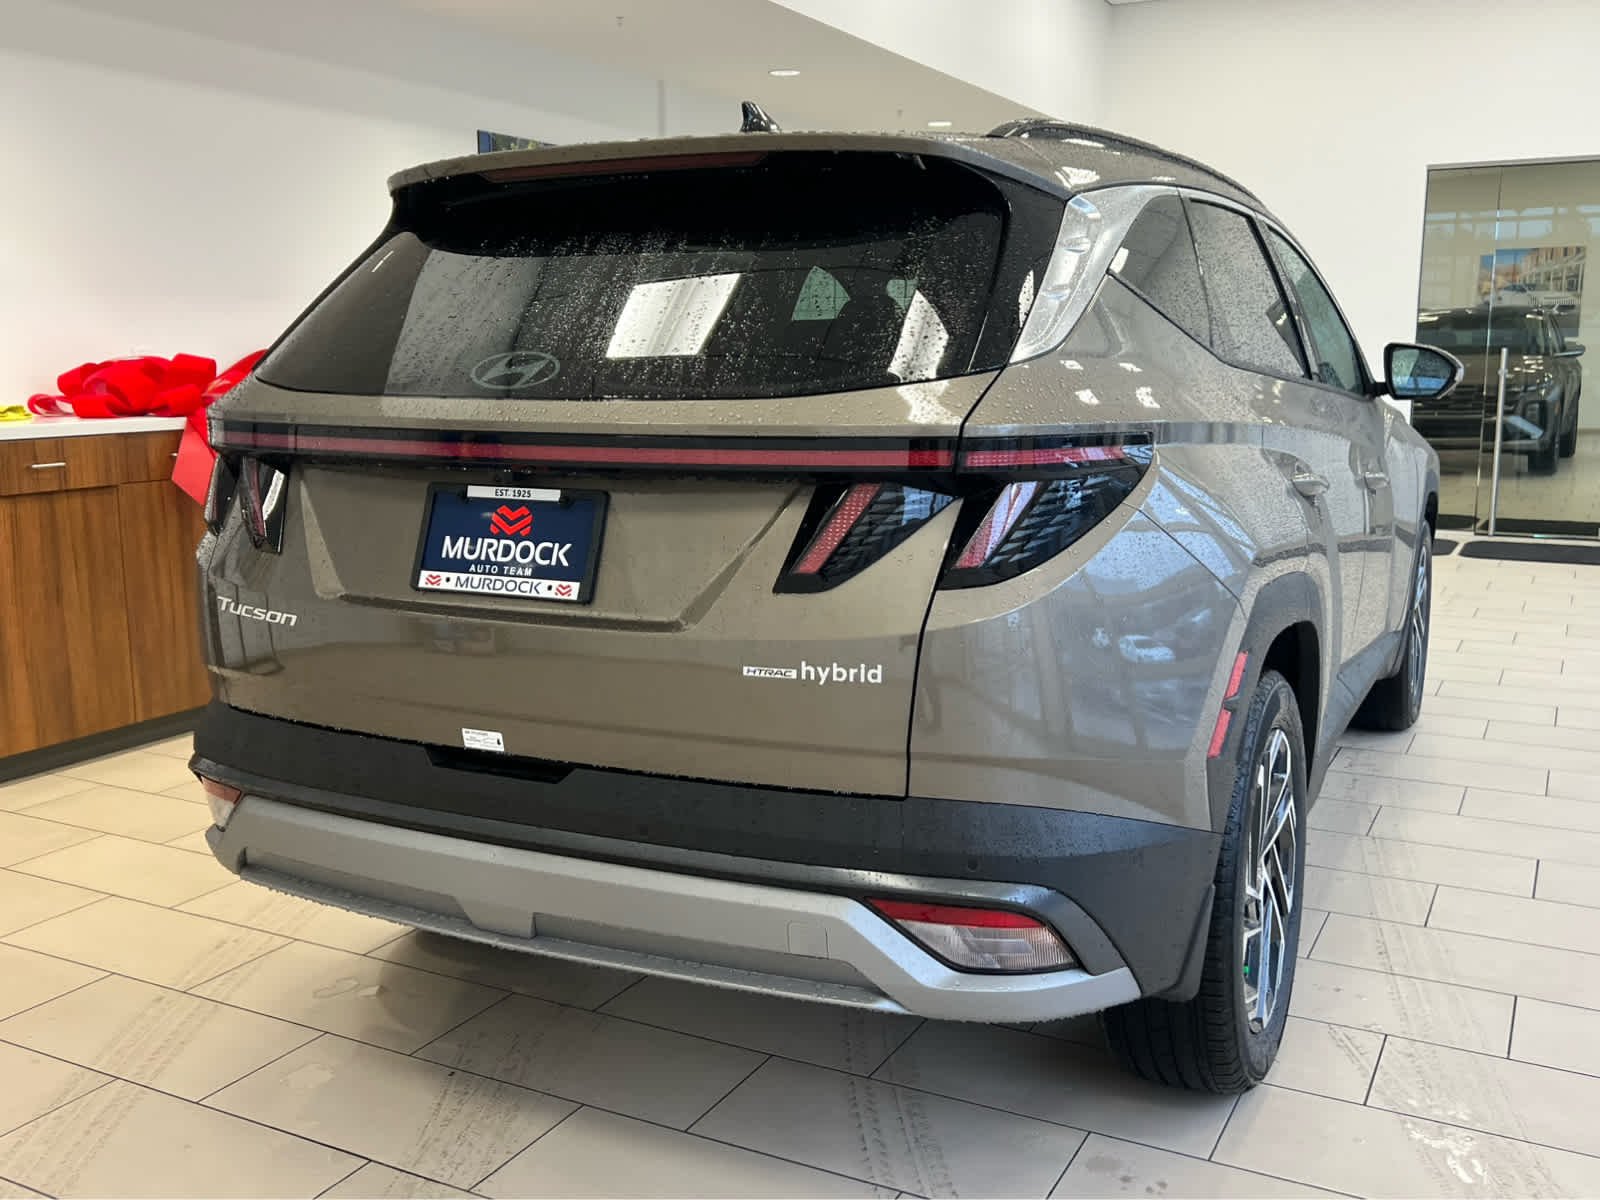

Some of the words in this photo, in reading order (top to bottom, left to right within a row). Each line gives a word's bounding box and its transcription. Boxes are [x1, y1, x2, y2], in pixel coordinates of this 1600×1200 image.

[494, 488, 511, 498] EST.
[512, 489, 532, 498] 1925
[441, 535, 572, 567] MURDOCK
[469, 563, 498, 574] AUTO
[503, 565, 533, 576] TEAM
[454, 575, 542, 595] MURDOCK
[217, 596, 297, 626] Tucson
[746, 668, 793, 677] HTRAC
[801, 660, 882, 685] hybrid
